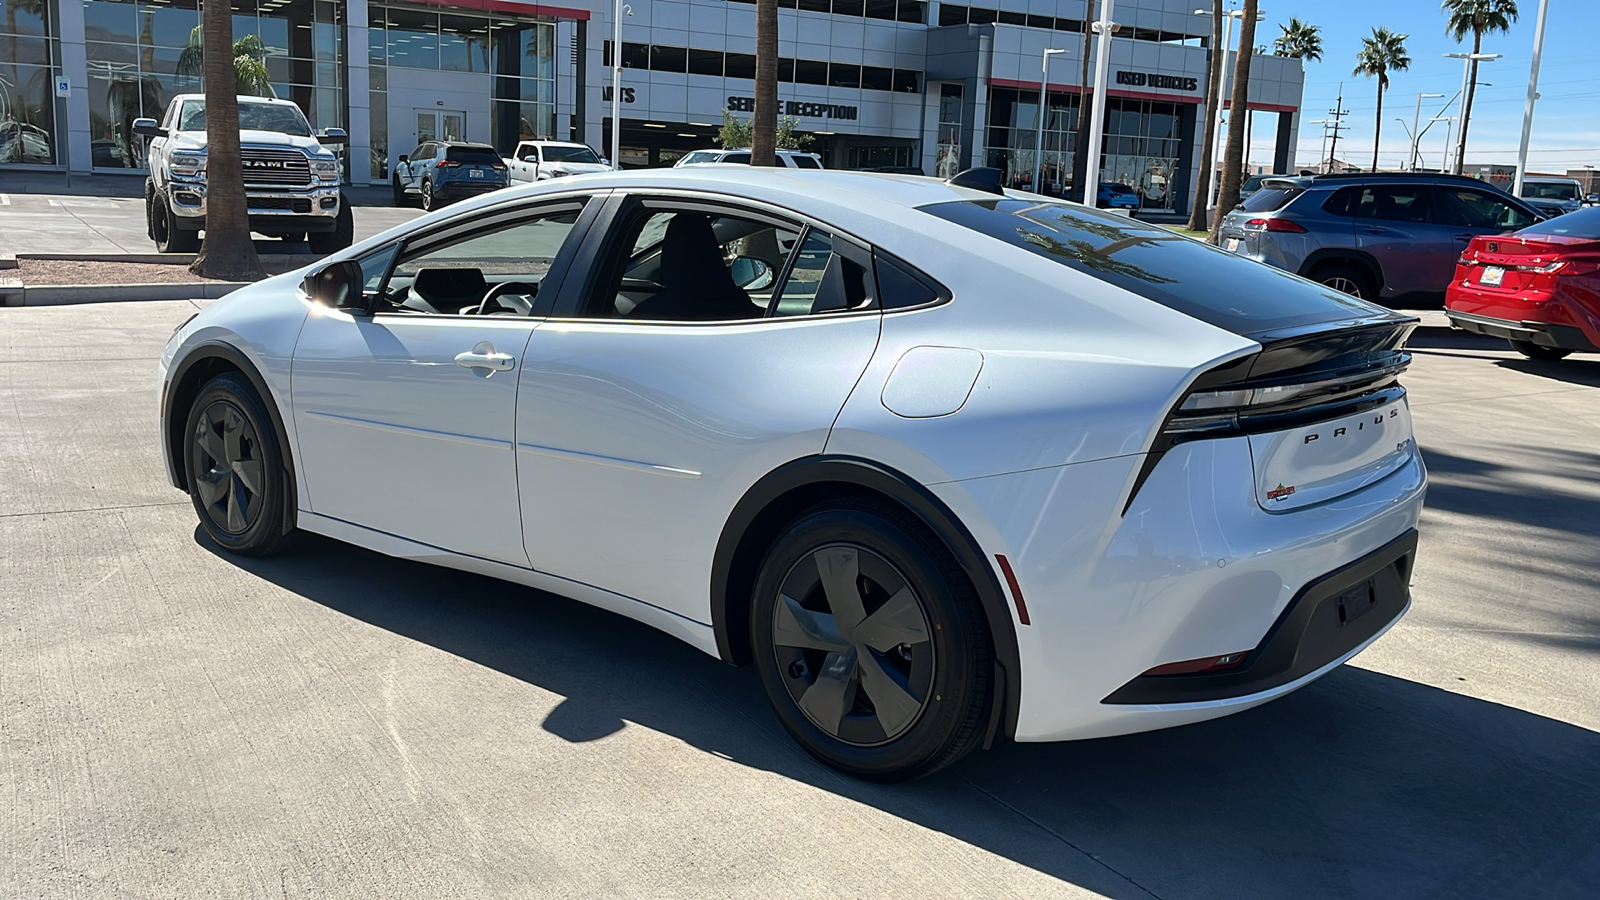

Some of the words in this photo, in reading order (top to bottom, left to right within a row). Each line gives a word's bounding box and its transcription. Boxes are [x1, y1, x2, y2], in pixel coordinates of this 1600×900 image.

[1117, 70, 1147, 87] USED
[1147, 73, 1198, 91] VEHICLES
[727, 96, 784, 114] SERE
[785, 101, 858, 120] RECEPTION
[241, 160, 281, 168] RAM
[1304, 408, 1398, 445] PRIUS
